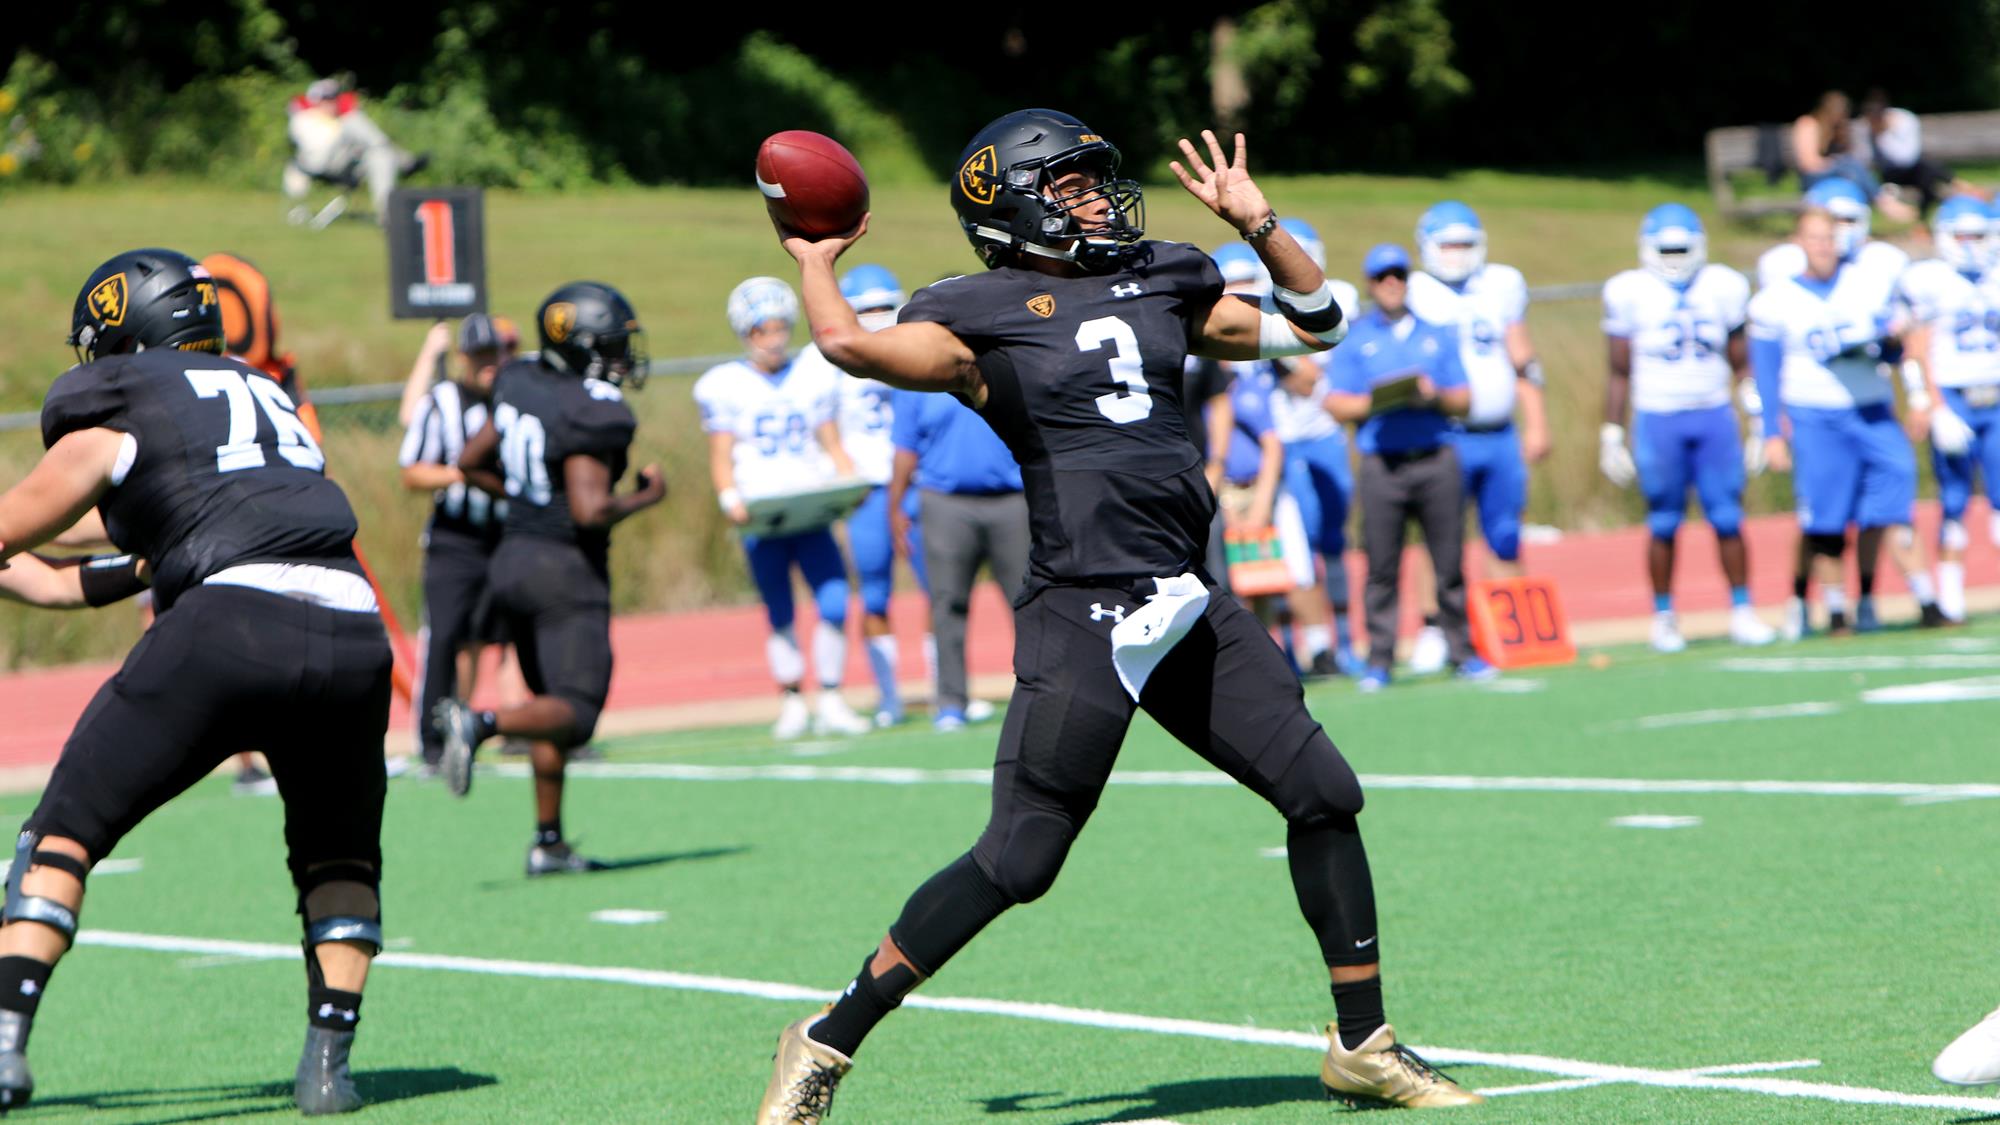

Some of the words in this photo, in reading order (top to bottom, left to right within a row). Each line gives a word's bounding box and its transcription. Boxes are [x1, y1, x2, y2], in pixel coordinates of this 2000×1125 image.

[414, 198, 455, 286] 1
[196, 283, 217, 305] 76
[1075, 315, 1153, 424] 3
[1661, 319, 1712, 361] 35
[184, 369, 325, 473] 76
[1490, 586, 1559, 645] 30
